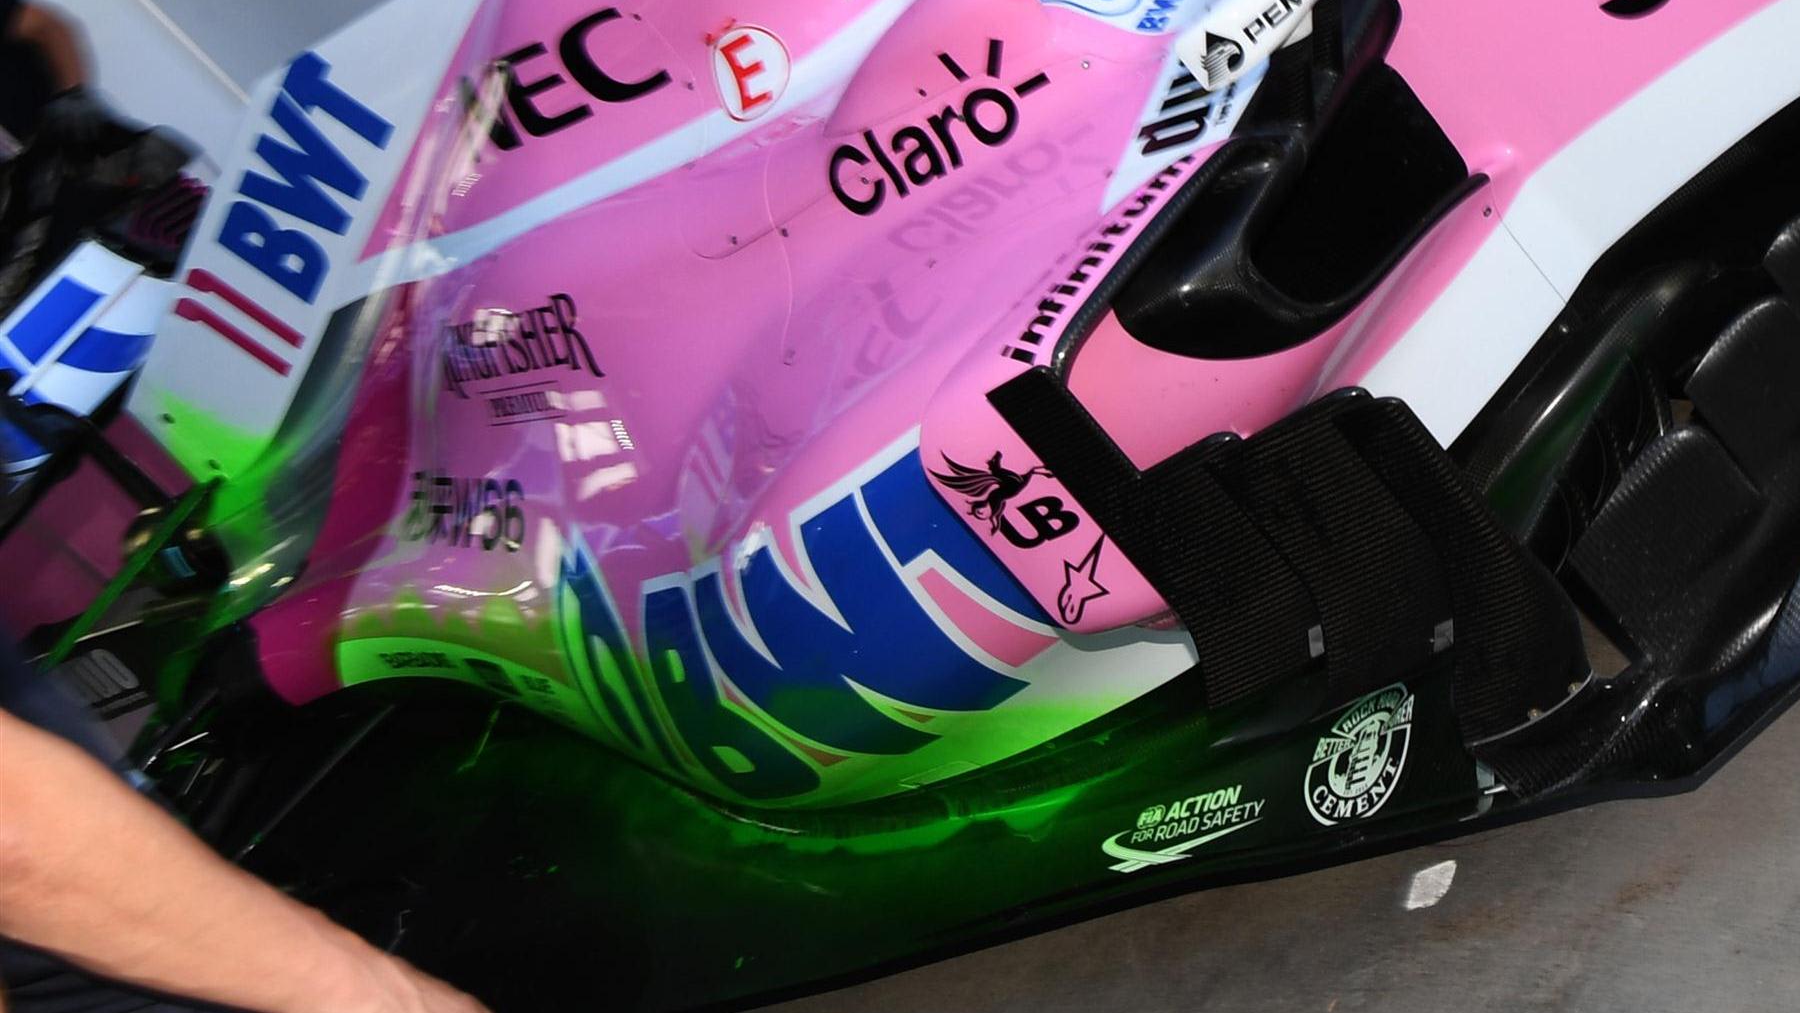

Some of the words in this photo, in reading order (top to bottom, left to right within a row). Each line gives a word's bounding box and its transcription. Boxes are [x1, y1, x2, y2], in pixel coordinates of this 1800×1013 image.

[462, 7, 673, 159] NEC
[719, 33, 775, 113] E
[218, 50, 397, 306] BWT
[829, 87, 1020, 217] Claro
[1001, 154, 1197, 366] infinitum
[173, 267, 307, 378] 11
[1130, 826, 1156, 845] FOR
[1154, 817, 1199, 844] ROAD
[1202, 797, 1266, 833] SAFETY
[1164, 784, 1243, 822] ACTION
[1310, 757, 1400, 820] CEMENT
